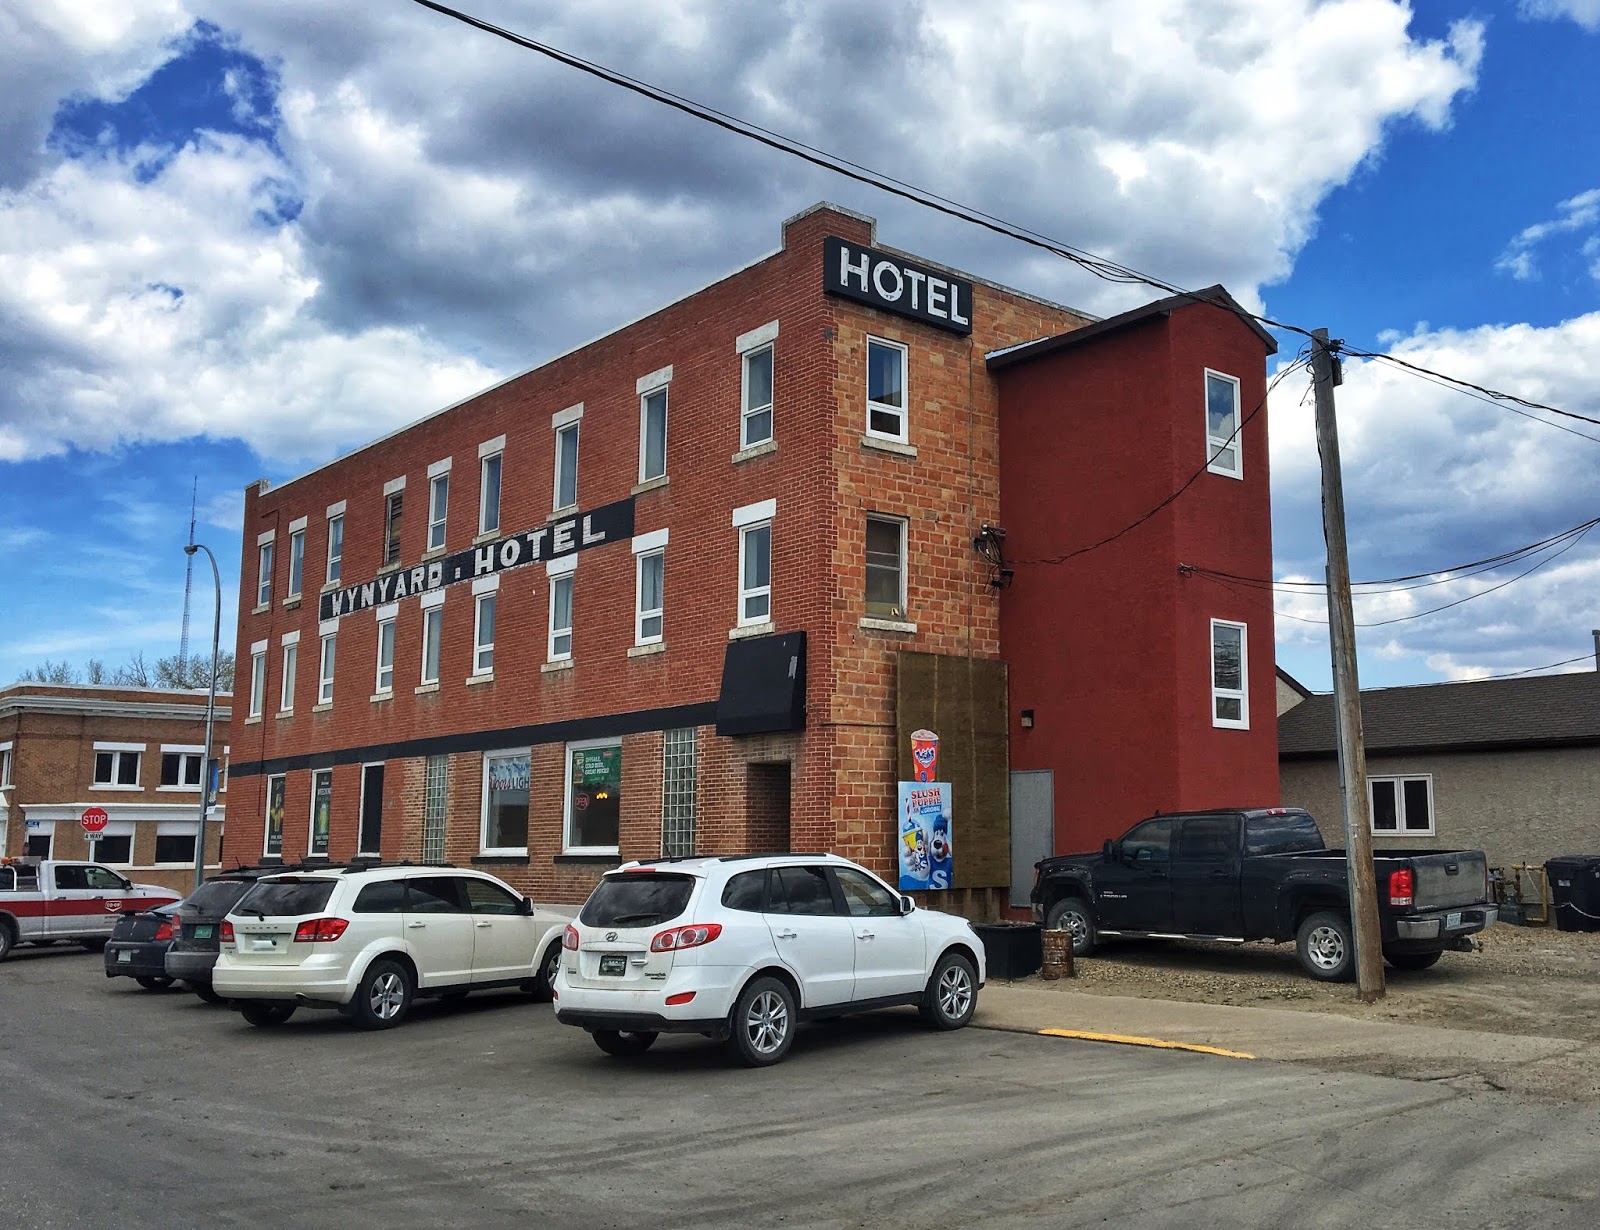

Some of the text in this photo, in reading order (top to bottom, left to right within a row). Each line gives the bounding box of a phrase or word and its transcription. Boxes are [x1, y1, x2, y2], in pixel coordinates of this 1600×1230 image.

[840, 246, 969, 326] HOTEL
[331, 514, 606, 617] WYNYARD HOTEL
[512, 777, 530, 790] LIGH
[911, 787, 941, 800] SLUSH
[912, 797, 942, 808] PUPPIE
[82, 814, 107, 825] STOP
